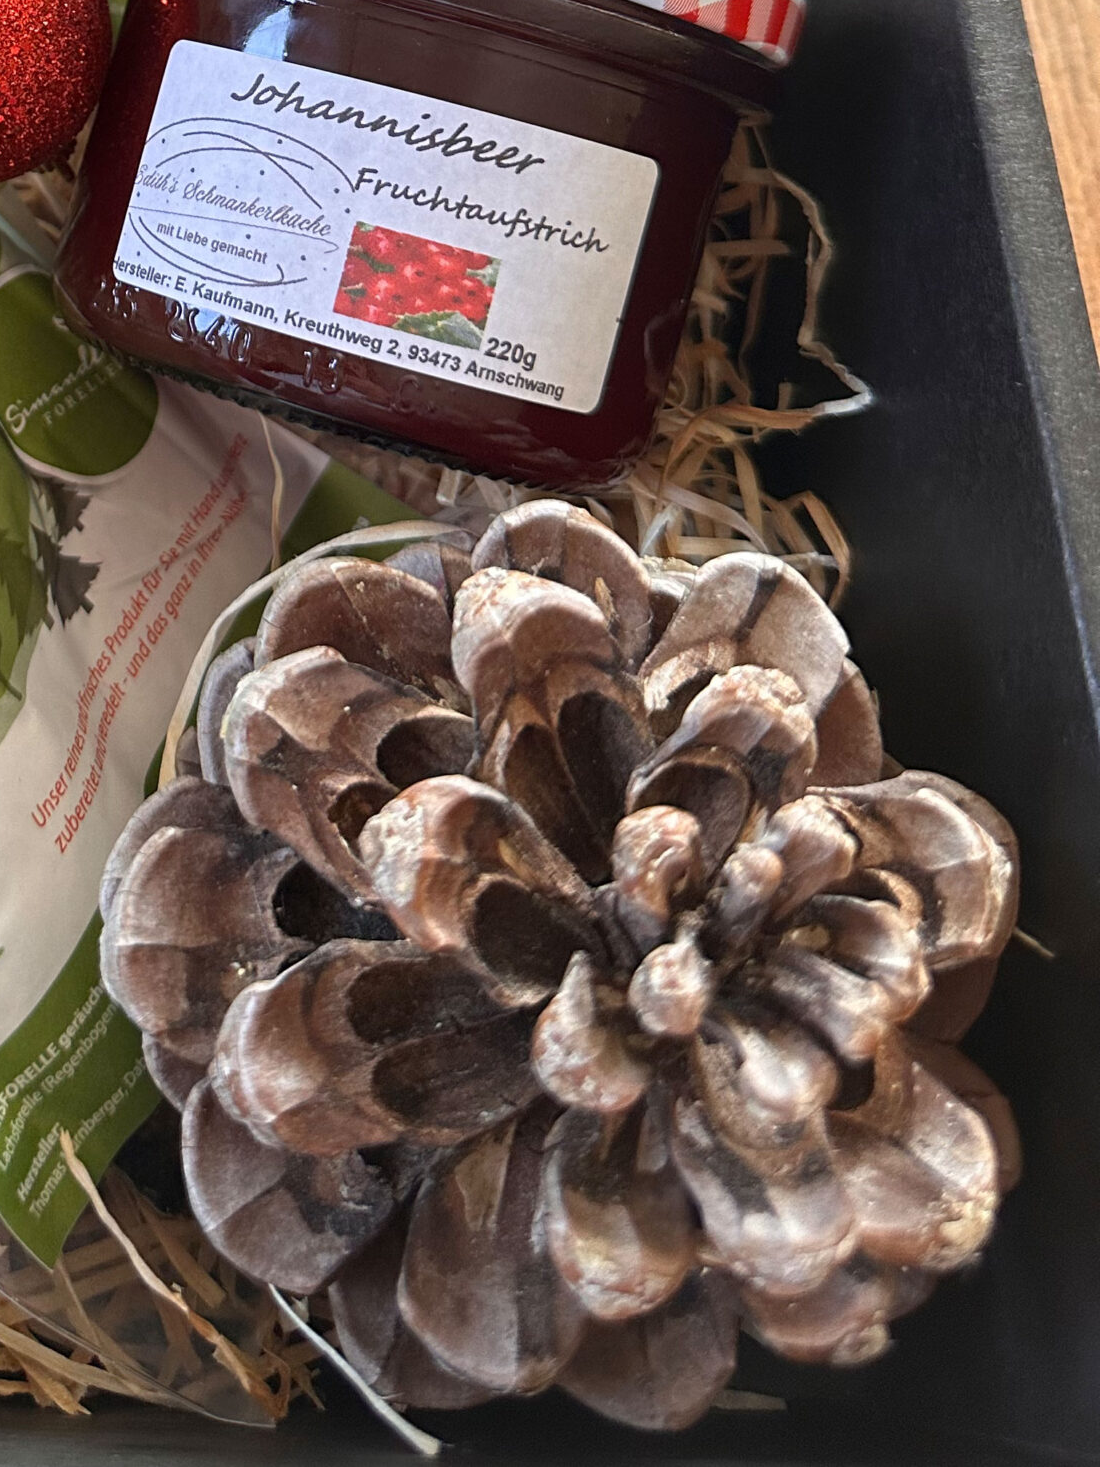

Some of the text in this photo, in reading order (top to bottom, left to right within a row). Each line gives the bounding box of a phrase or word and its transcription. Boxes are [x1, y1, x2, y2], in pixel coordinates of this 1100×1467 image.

[231, 73, 546, 176] Johannisbeer
[134, 163, 180, 194] Edith's
[354, 168, 611, 254] Fruchtaufstrich
[156, 221, 269, 265] mit Liebe gemacht
[113, 255, 172, 289] Hersteller:
[174, 275, 189, 294] E.
[191, 281, 279, 324] Kaufmann,
[284, 308, 383, 355] Kreuthweg
[386, 339, 403, 361] 2,
[407, 346, 462, 373] 93473
[464, 360, 565, 401] Arnschwang
[484, 337, 538, 372] 220g
[188, 479, 222, 528] Hand
[158, 544, 180, 572] Sie
[175, 521, 197, 550] mit
[194, 523, 224, 564] Ihrer
[141, 565, 164, 597] für
[183, 554, 201, 578] in
[164, 573, 193, 621] ganz
[104, 587, 150, 656] Produkt
[146, 613, 169, 646] das
[126, 635, 152, 679] und
[77, 650, 112, 712] frisches
[76, 702, 90, 736] und
[99, 681, 127, 741] veredelt
[64, 728, 87, 781] reines
[93, 734, 108, 773] und
[31, 773, 70, 828] Unser
[54, 764, 103, 855] zubereitet
[29, 1161, 68, 1220] Thomas
[60, 1086, 131, 1158] rnberger,
